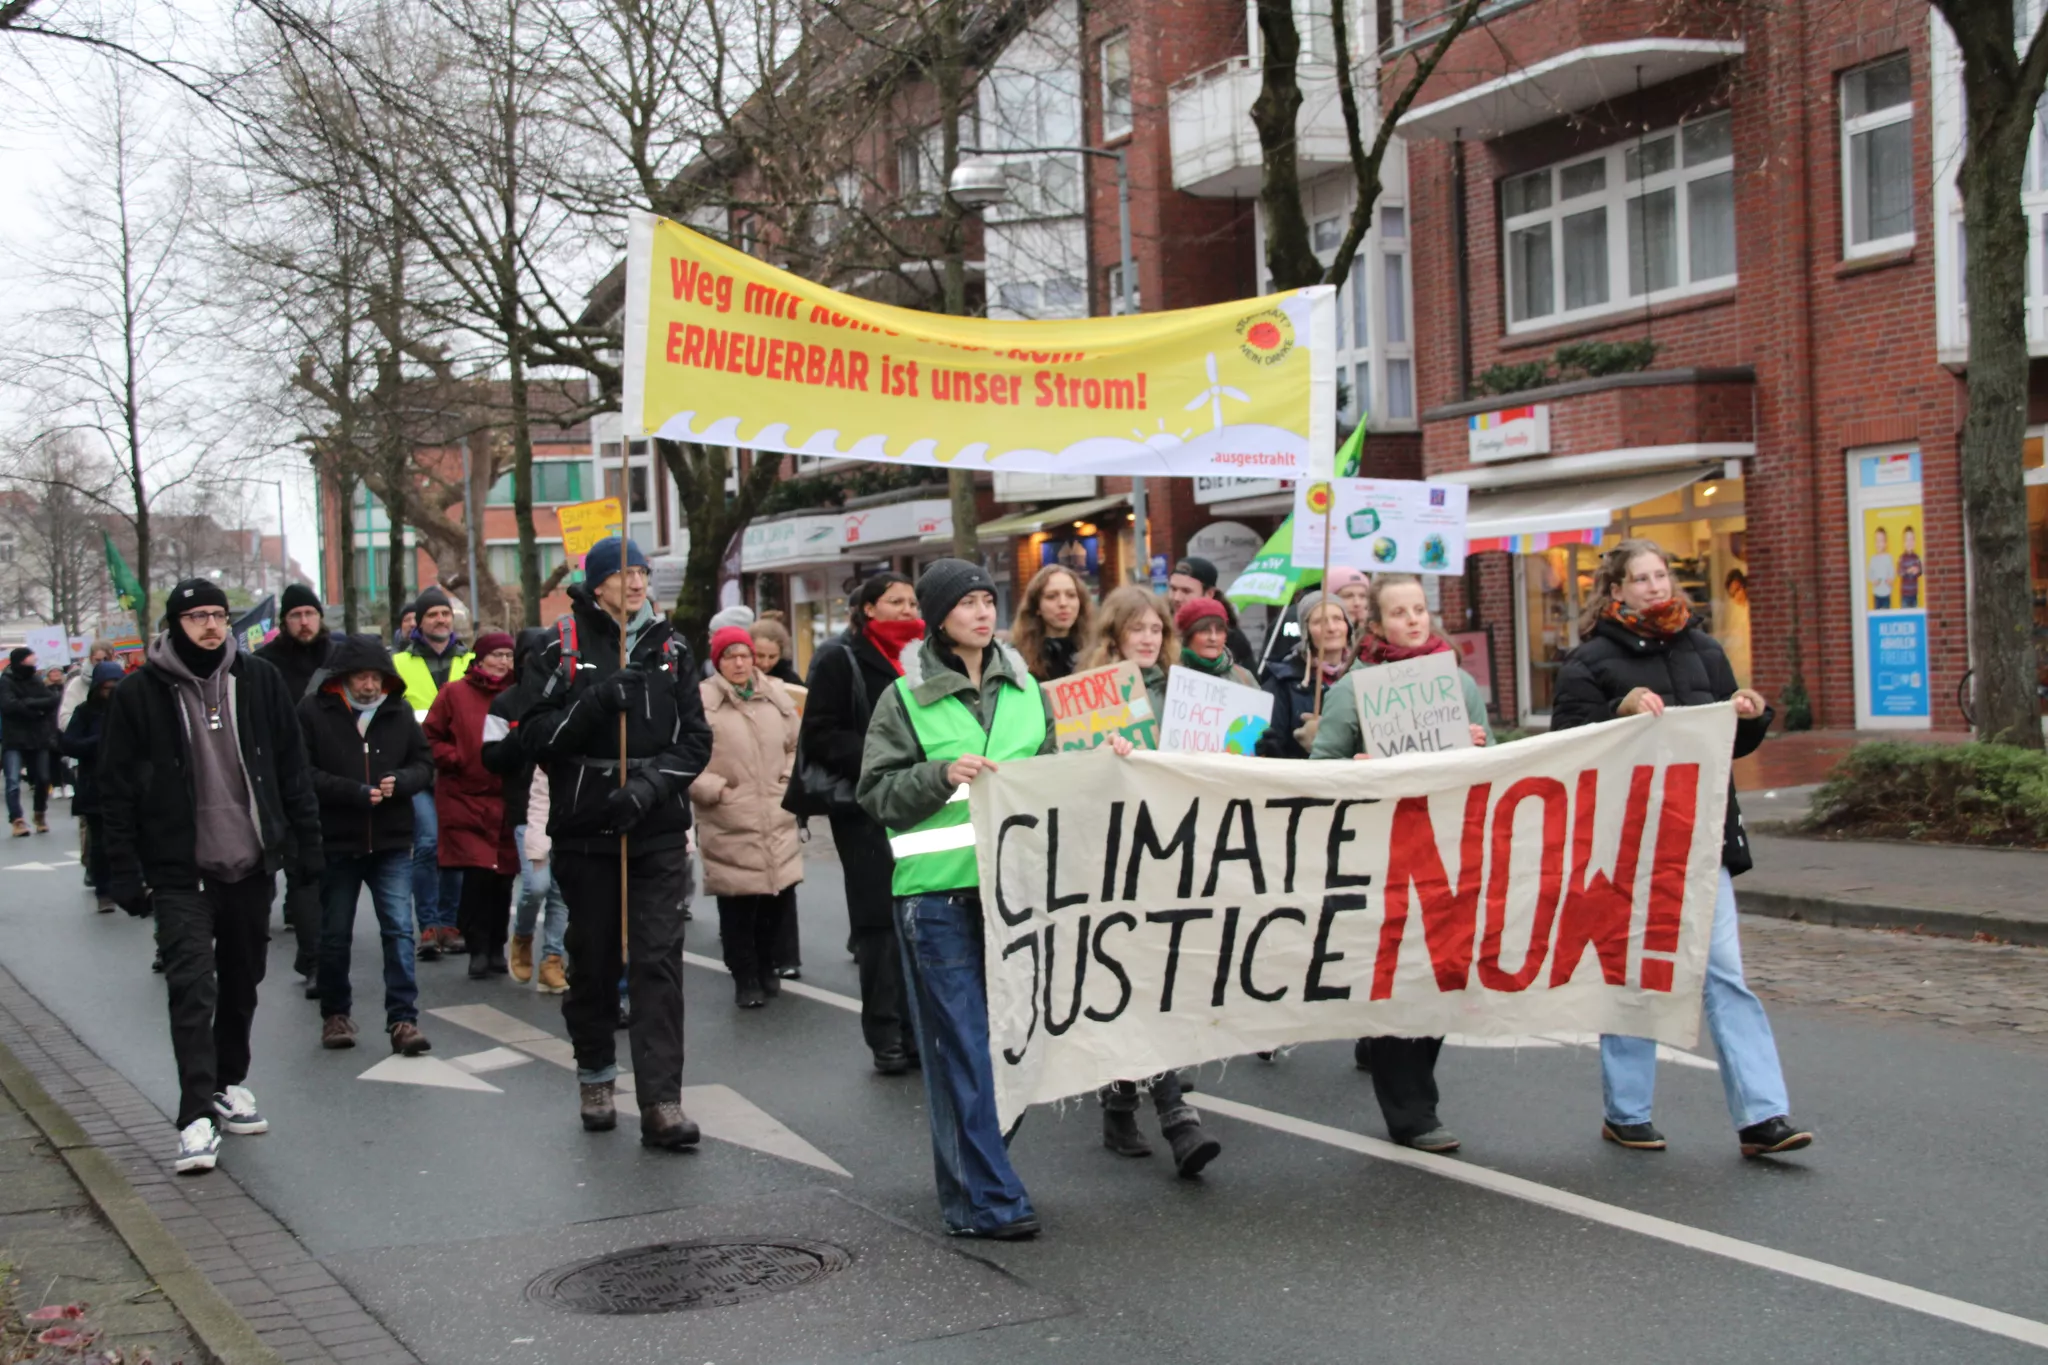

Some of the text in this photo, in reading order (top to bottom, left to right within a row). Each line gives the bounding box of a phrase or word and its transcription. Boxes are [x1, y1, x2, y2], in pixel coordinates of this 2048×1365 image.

[670, 257, 733, 313] Weg
[666, 321, 869, 392] ERNEUERBAR
[881, 355, 919, 397] ist
[931, 368, 1022, 406] unser
[1034, 370, 1147, 410] Strom!
[1211, 451, 1296, 467] .ausgestrahlt
[1176, 674, 1229, 706] THE TIME
[1387, 664, 1420, 682] Die
[1045, 668, 1120, 720] UPPORT
[1363, 675, 1457, 719] NATUR
[1172, 699, 1224, 726] TO ACT
[1368, 704, 1462, 740] hat keine
[1168, 728, 1180, 749] IS
[1377, 728, 1453, 757] WAHL
[995, 763, 1699, 999] CLIMATE NOW!
[1002, 894, 1366, 1065] JUSTICE
